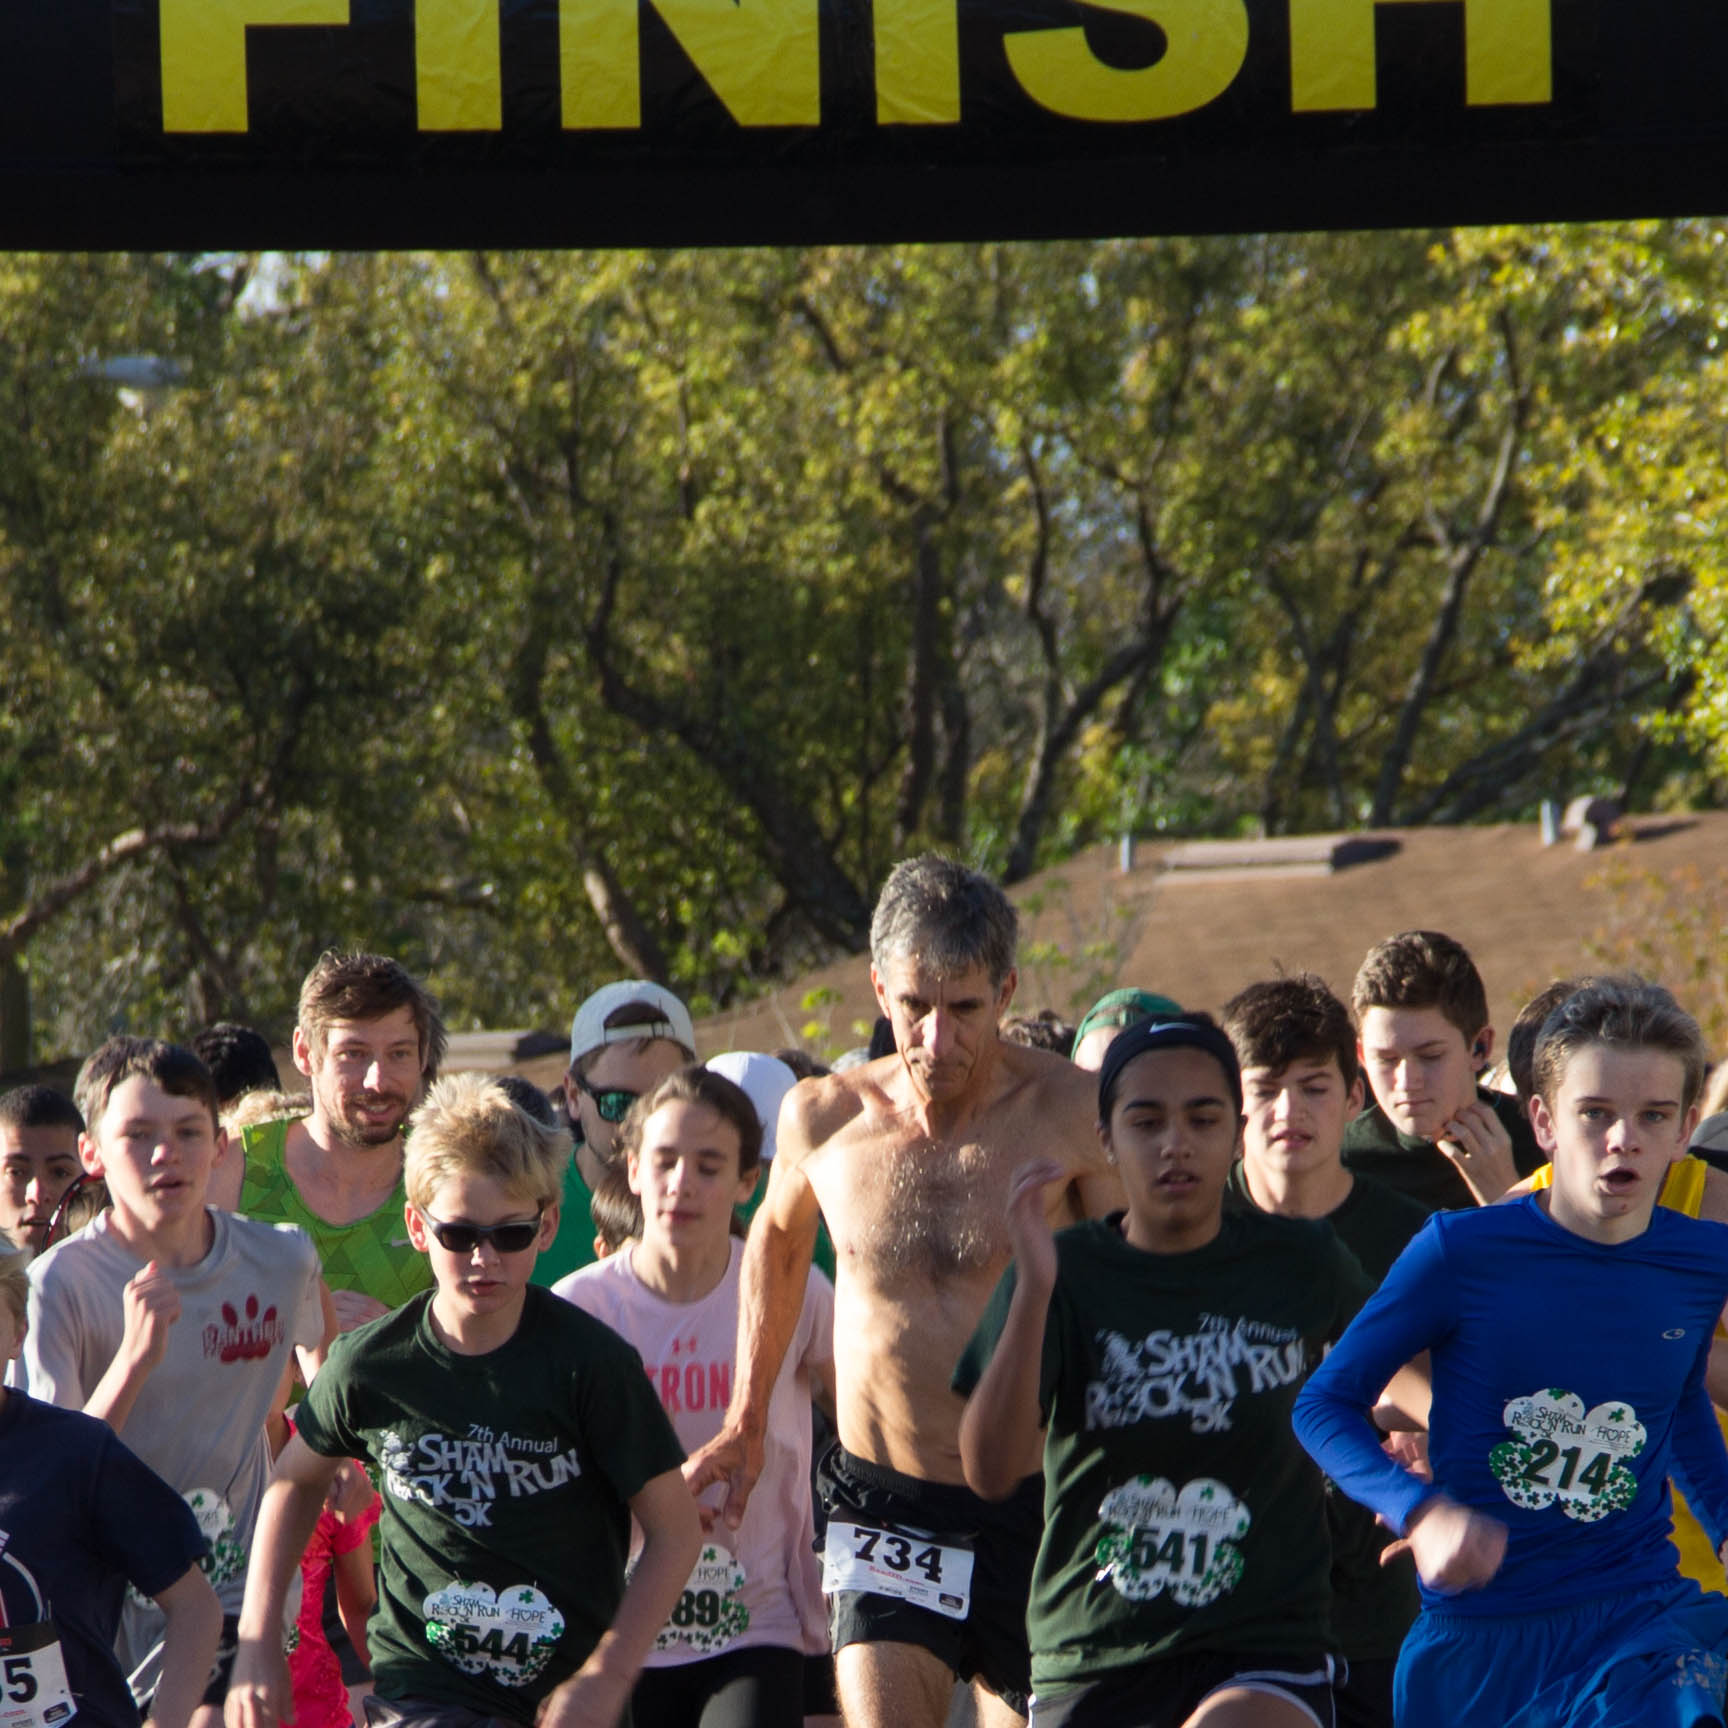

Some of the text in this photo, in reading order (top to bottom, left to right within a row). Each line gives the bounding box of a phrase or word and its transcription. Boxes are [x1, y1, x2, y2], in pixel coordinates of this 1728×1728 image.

[417, 1433, 510, 1473] SHAM
[466, 1423, 559, 1454] 7th Annual
[505, 1447, 582, 1497] RUN
[1523, 1438, 1612, 1496] 214
[854, 1526, 943, 1585] 734
[1128, 1526, 1209, 1577] 541
[455, 1622, 529, 1666] 544
